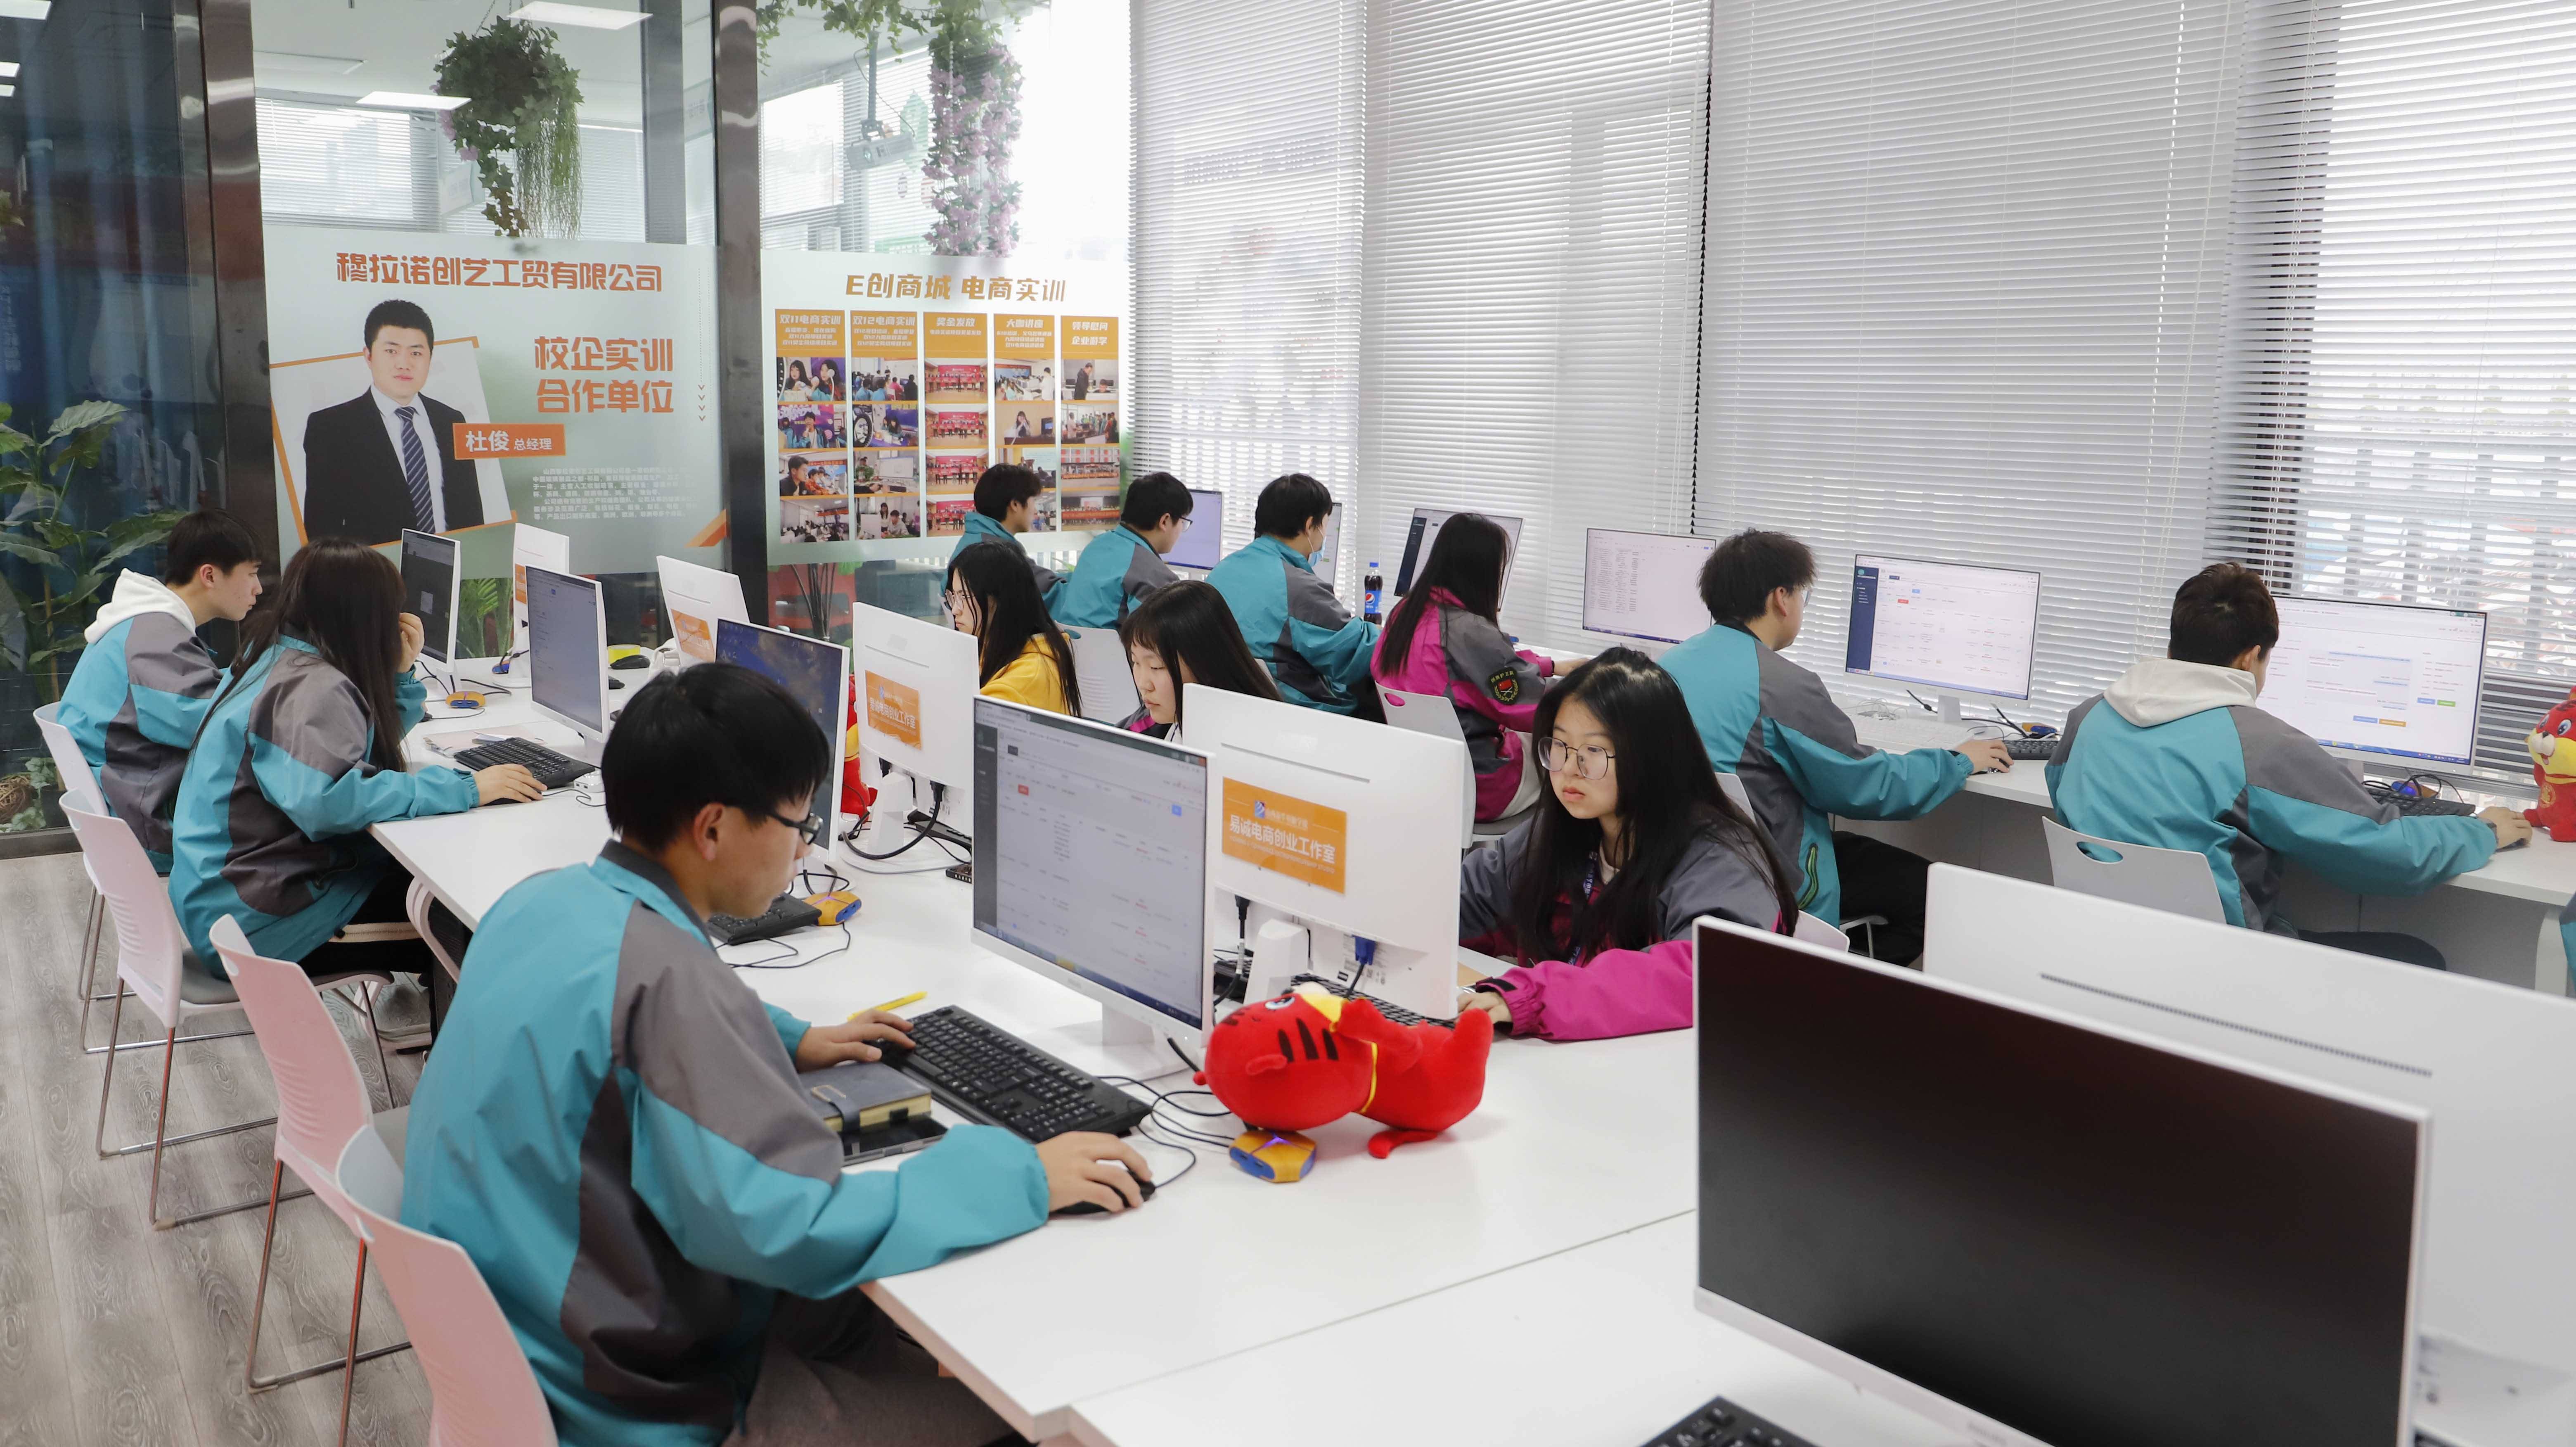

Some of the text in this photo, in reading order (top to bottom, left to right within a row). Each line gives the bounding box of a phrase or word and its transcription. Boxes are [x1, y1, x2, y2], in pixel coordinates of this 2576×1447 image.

[336, 252, 661, 292] 穆拉诺创艺工贸有限公司
[846, 273, 1065, 301] E创商城 电商实训
[779, 314, 841, 325] 双11电商实训
[853, 315, 915, 326] 双12电商实训
[936, 317, 975, 327] 奖金发放
[1006, 319, 1043, 328] 大咖讲座
[1072, 321, 1108, 330] 领导慰问
[1071, 336, 1108, 345] 企业游学
[534, 336, 673, 372] 校企实训
[537, 379, 674, 413] 合作单位
[466, 430, 552, 452] 杜俊 总经理
[1230, 814, 1335, 865] 易诚电商创业工作室
